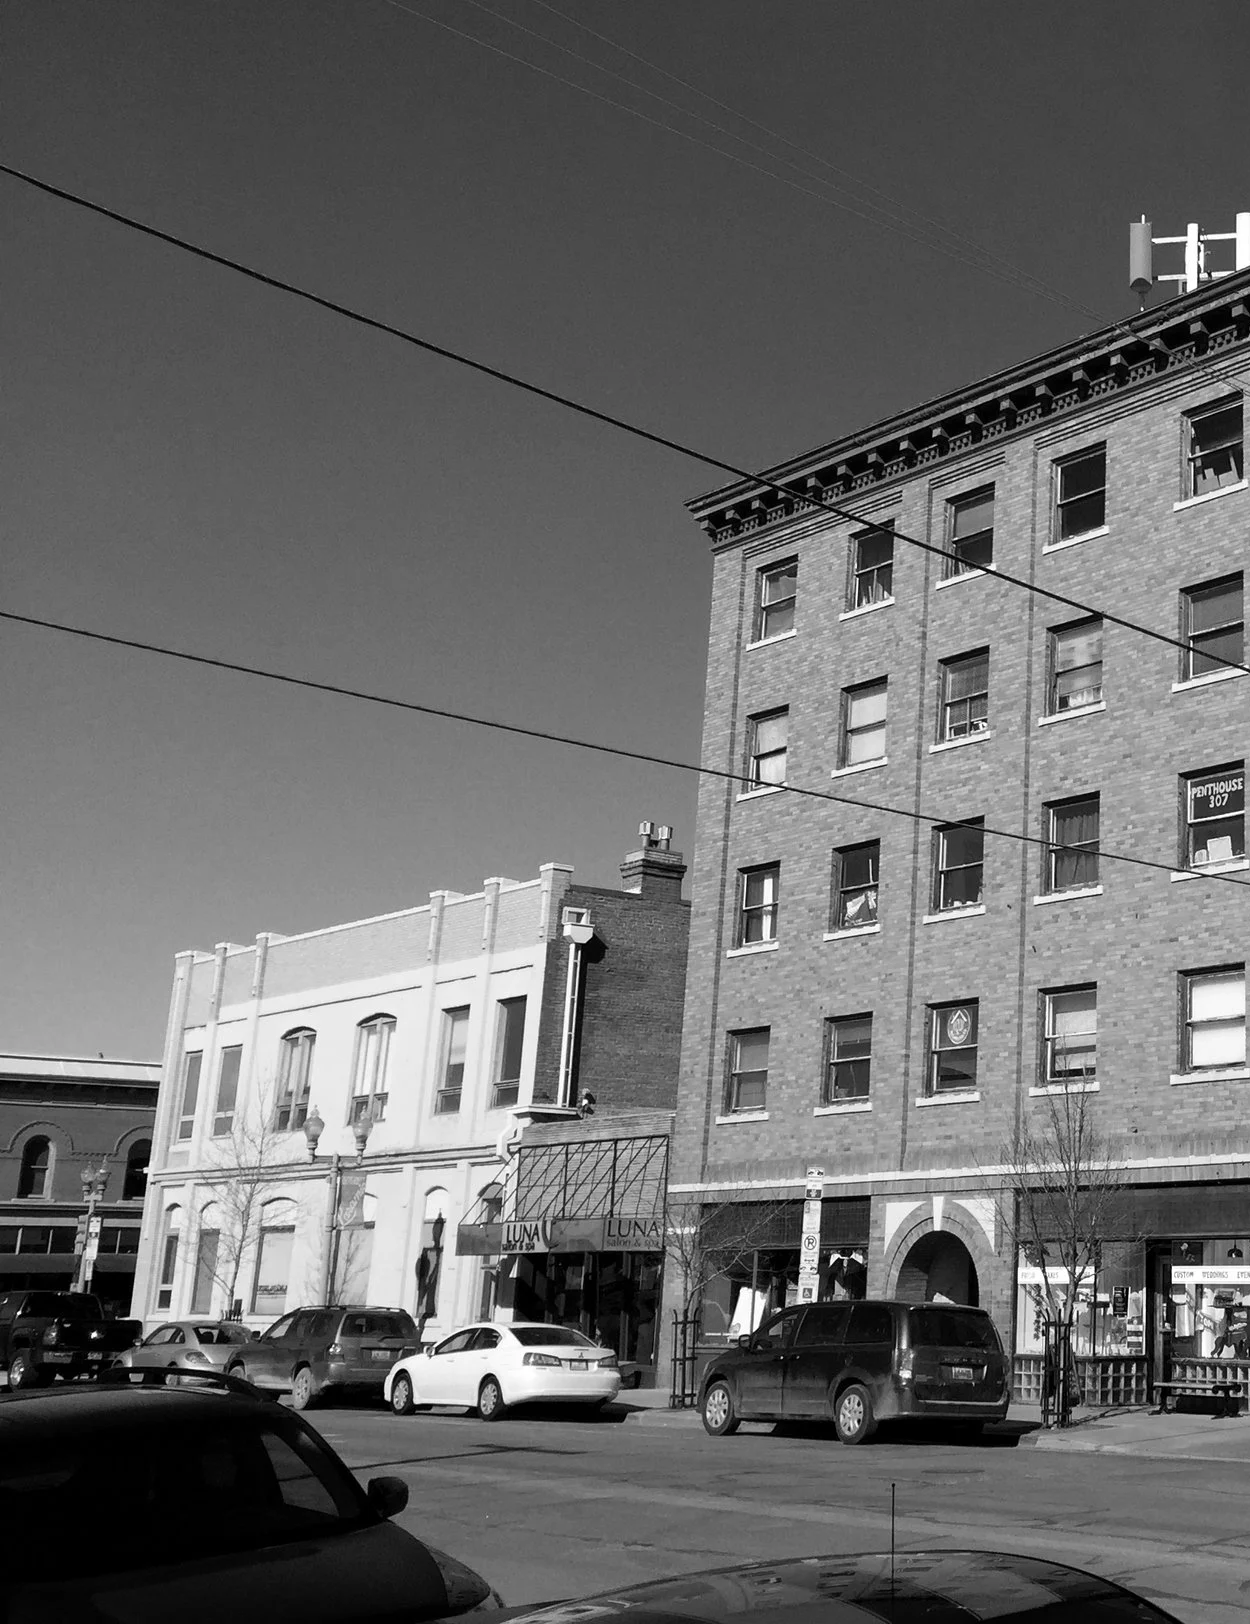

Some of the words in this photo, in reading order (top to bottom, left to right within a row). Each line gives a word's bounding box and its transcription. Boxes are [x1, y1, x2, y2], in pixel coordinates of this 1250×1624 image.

[1192, 777, 1244, 800] PENTHOUSE
[1209, 793, 1229, 809] 307
[506, 1223, 541, 1243] LUNA
[607, 1219, 661, 1238] LUNA
[502, 1242, 517, 1251] salon
[525, 1242, 536, 1252] spa
[606, 1237, 632, 1249] salon
[634, 1238, 642, 1248] &
[644, 1238, 660, 1251] spa
[1173, 1271, 1195, 1279] CUSTOM
[1202, 1271, 1229, 1279] WEDDINGS
